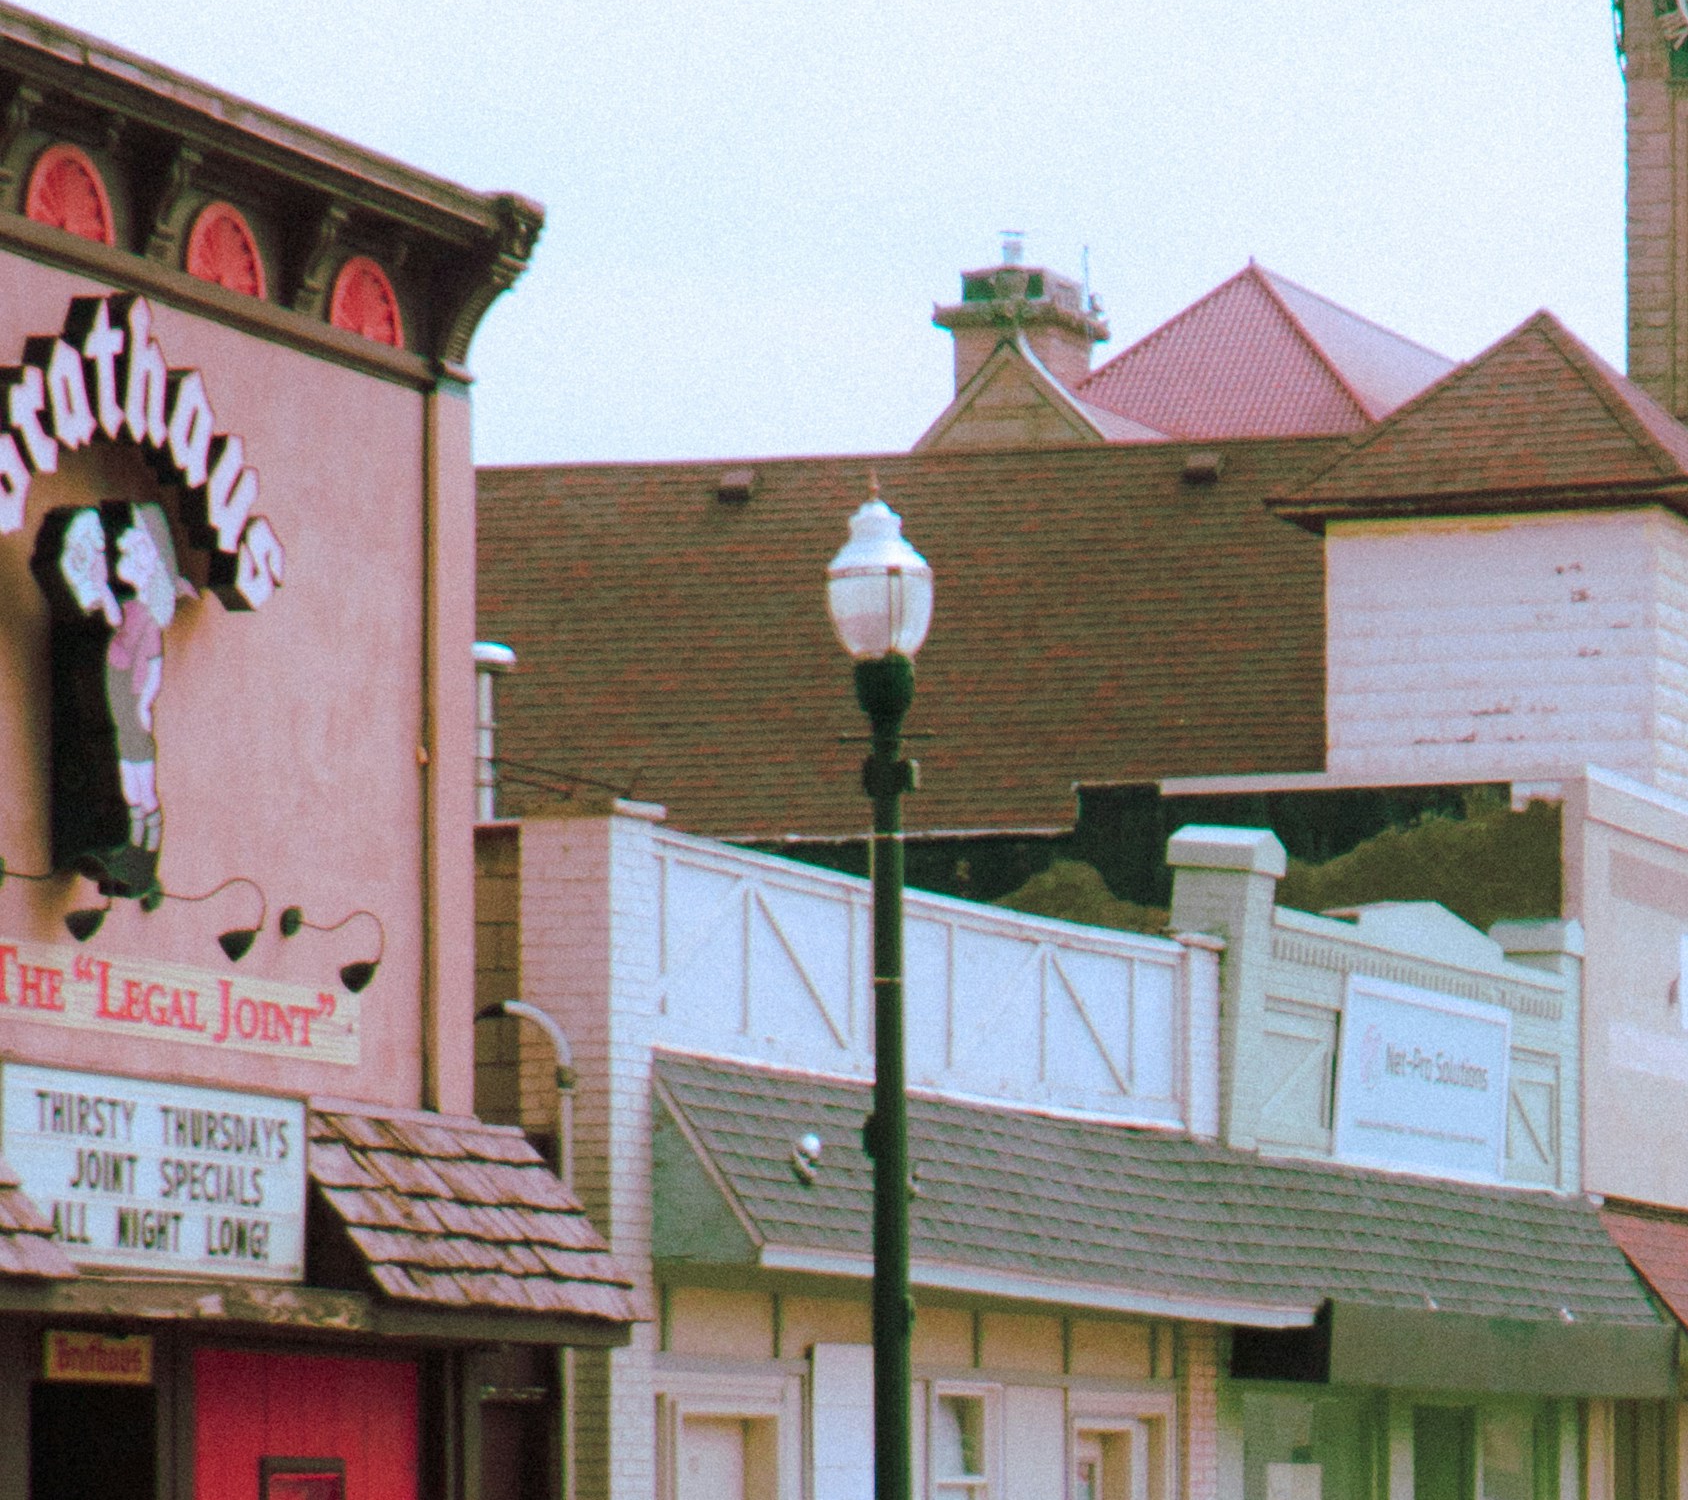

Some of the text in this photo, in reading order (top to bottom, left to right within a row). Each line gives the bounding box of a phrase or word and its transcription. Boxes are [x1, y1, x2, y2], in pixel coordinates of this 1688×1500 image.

[1386, 1042, 1488, 1092] Net-Pro Solutions
[36, 1088, 290, 1160] THIRSTY THURSDAYS
[68, 1147, 264, 1207] JOINT SPECIALS
[53, 1201, 91, 1244] ALL
[116, 1205, 184, 1252] NIGHT
